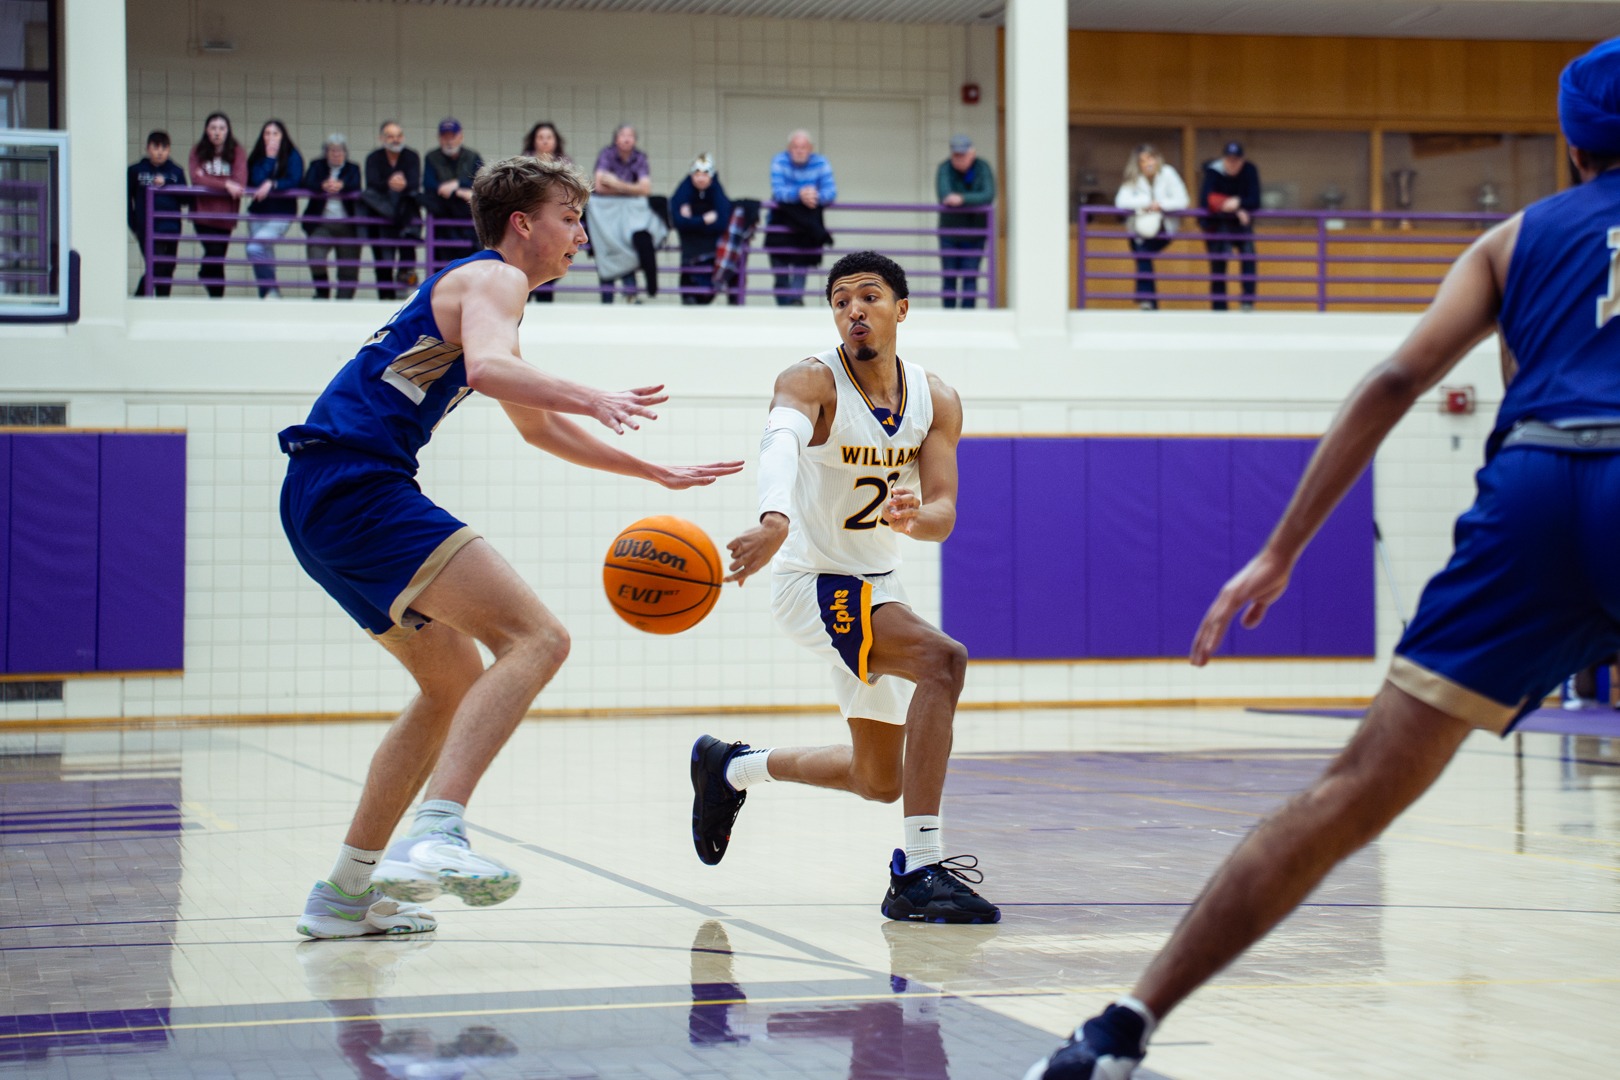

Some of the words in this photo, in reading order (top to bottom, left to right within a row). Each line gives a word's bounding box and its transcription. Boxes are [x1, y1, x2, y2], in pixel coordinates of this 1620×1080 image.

[613, 538, 687, 572] Wilson
[617, 583, 663, 604] EVO
[829, 589, 856, 634] Ephs
